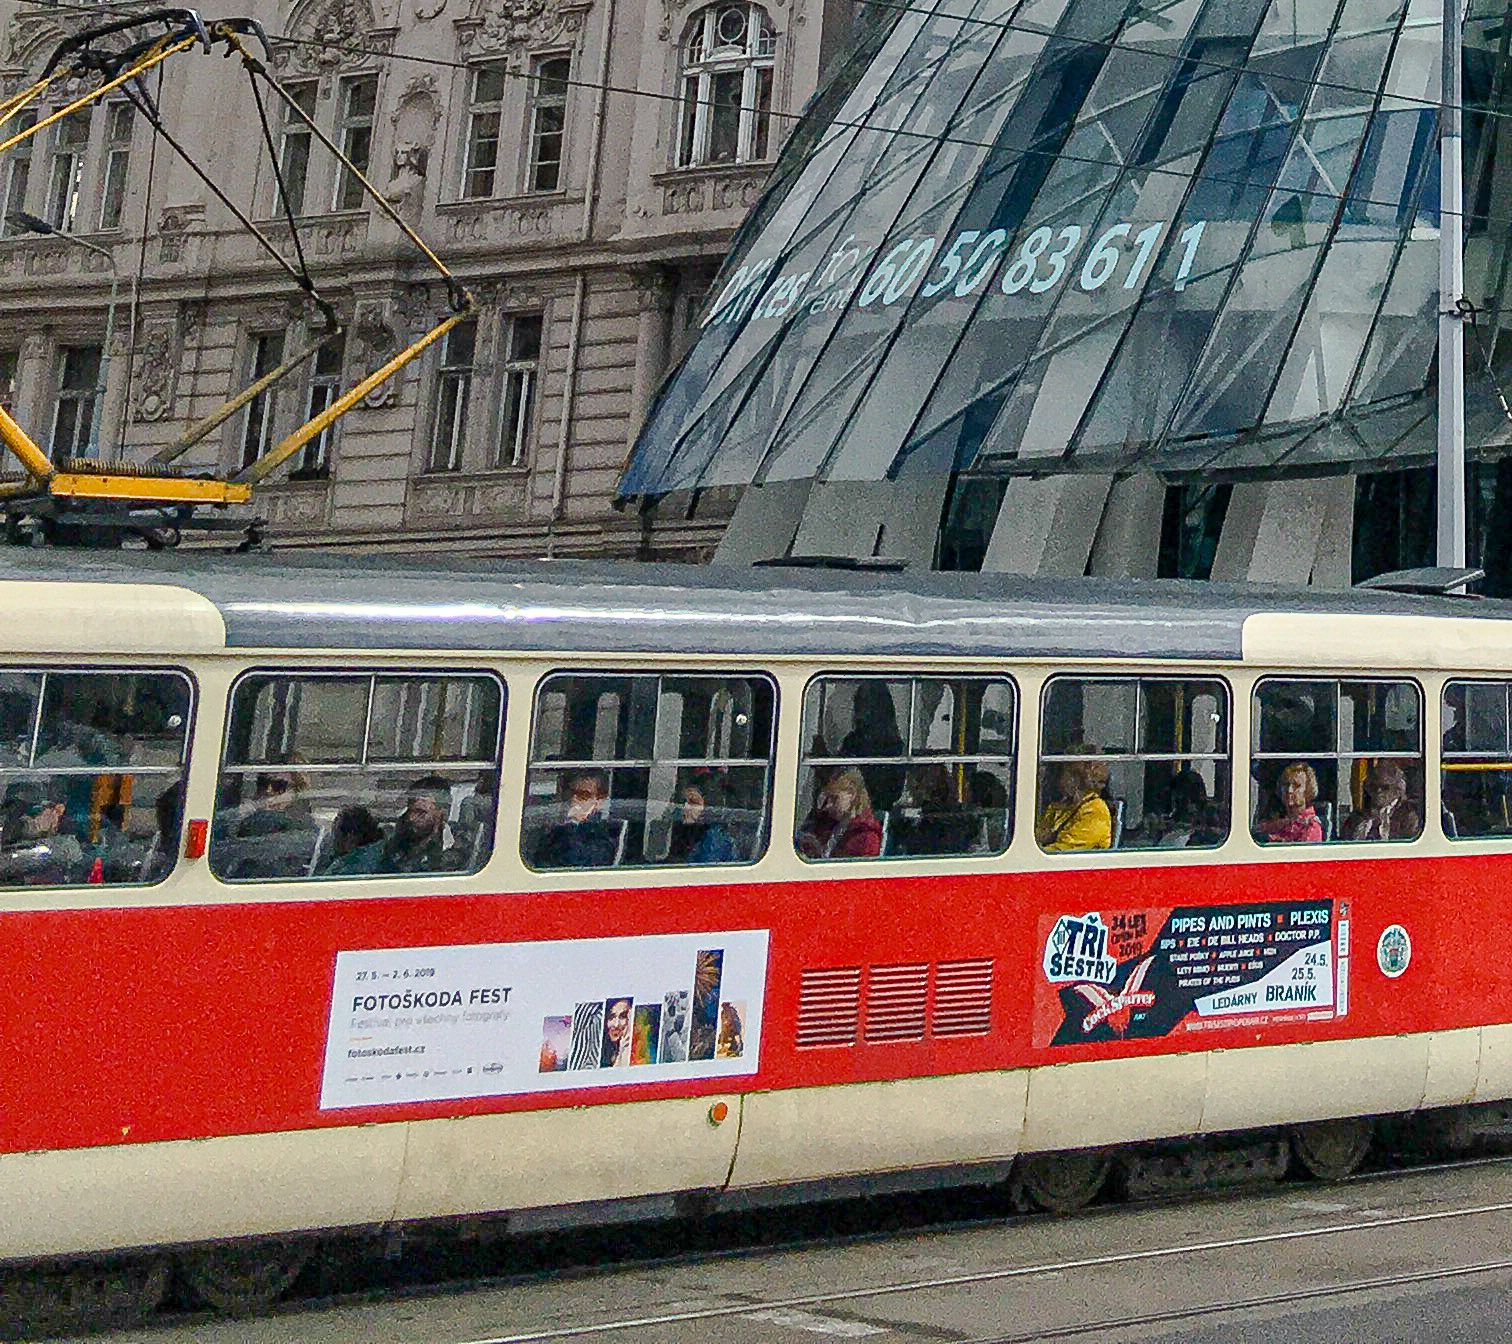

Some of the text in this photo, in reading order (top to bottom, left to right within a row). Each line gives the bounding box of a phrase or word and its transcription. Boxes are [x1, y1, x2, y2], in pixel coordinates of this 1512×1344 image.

[1171, 909, 1329, 934] PIPES AND PINTS PLEXIS
[1066, 915, 1106, 960] TŘI
[1274, 930, 1307, 942] DOCTOR
[1049, 952, 1115, 982] SESTRY
[1304, 952, 1329, 968] 24.5.
[1291, 967, 1317, 981] 25.5.
[352, 987, 513, 1012] FOTOŠKODA FEST
[1212, 981, 1317, 1010] LEDÁRNY BRANÍK
